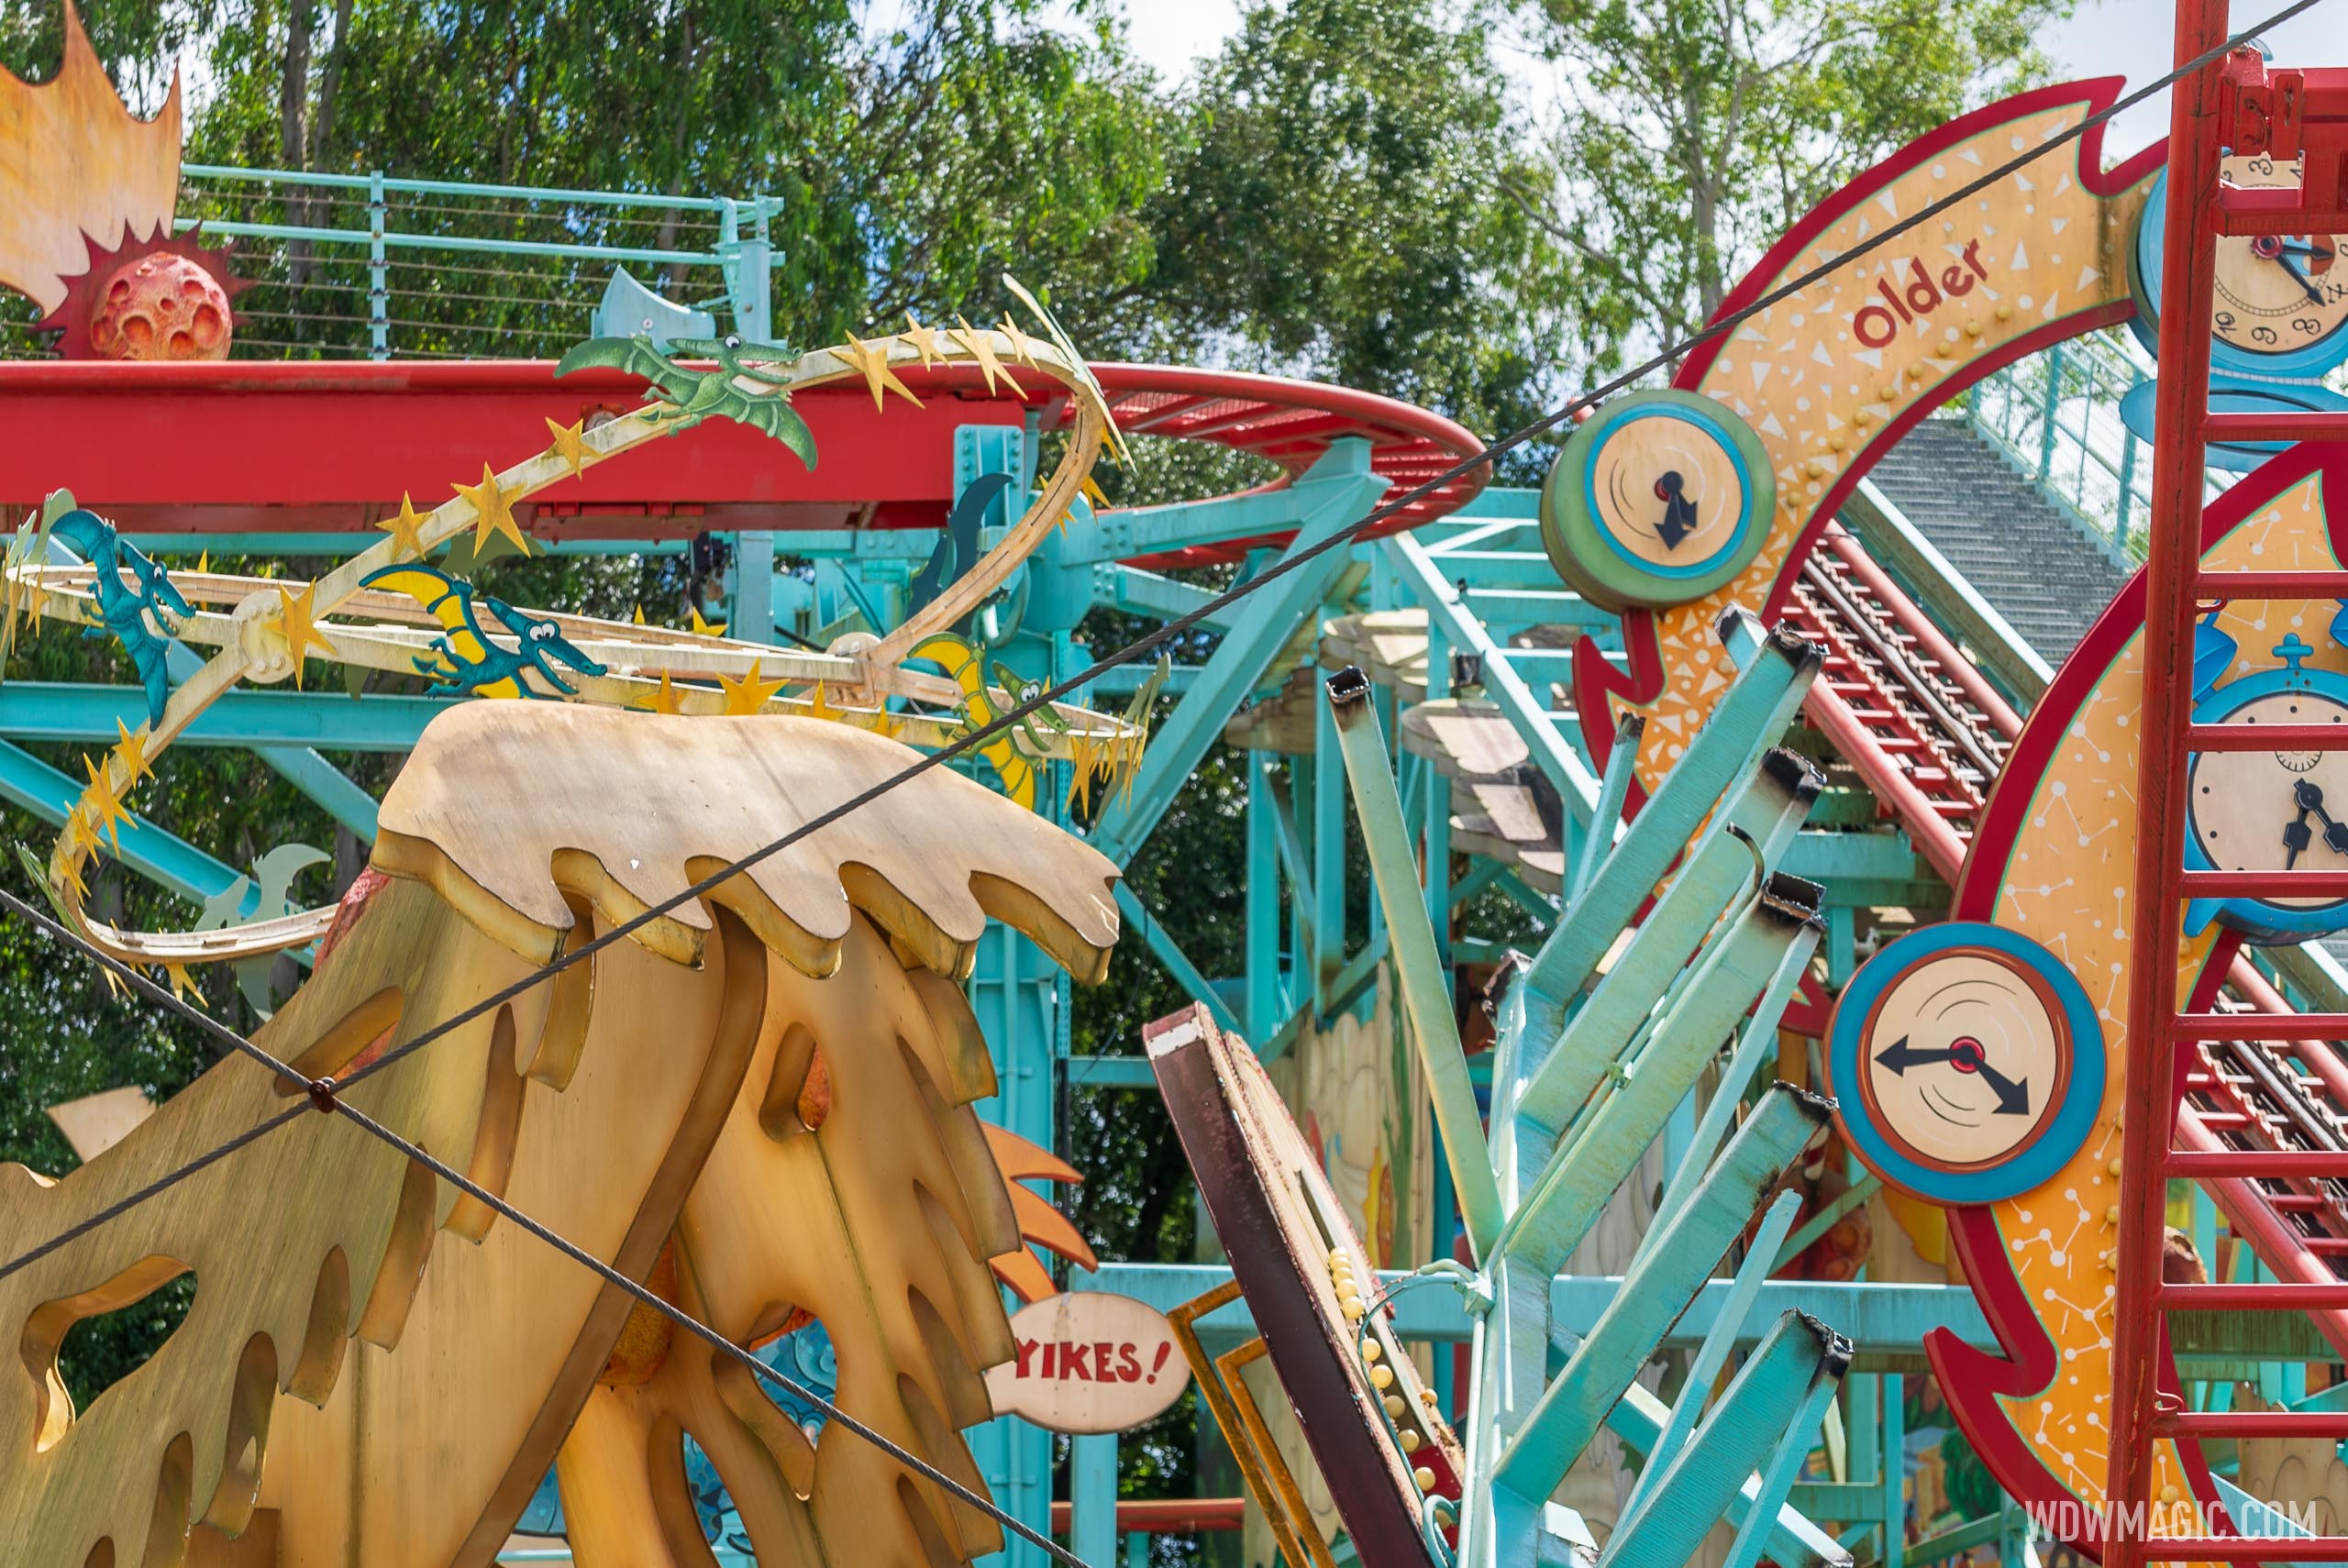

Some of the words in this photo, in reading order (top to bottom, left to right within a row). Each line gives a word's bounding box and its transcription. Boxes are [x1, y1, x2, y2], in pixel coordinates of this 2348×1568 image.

[2248, 159, 2274, 176] 3
[1854, 237, 1988, 348] Older
[2252, 326, 2277, 345] 9
[2292, 318, 2321, 335] 8
[1015, 1338, 1171, 1386] YIKES!
